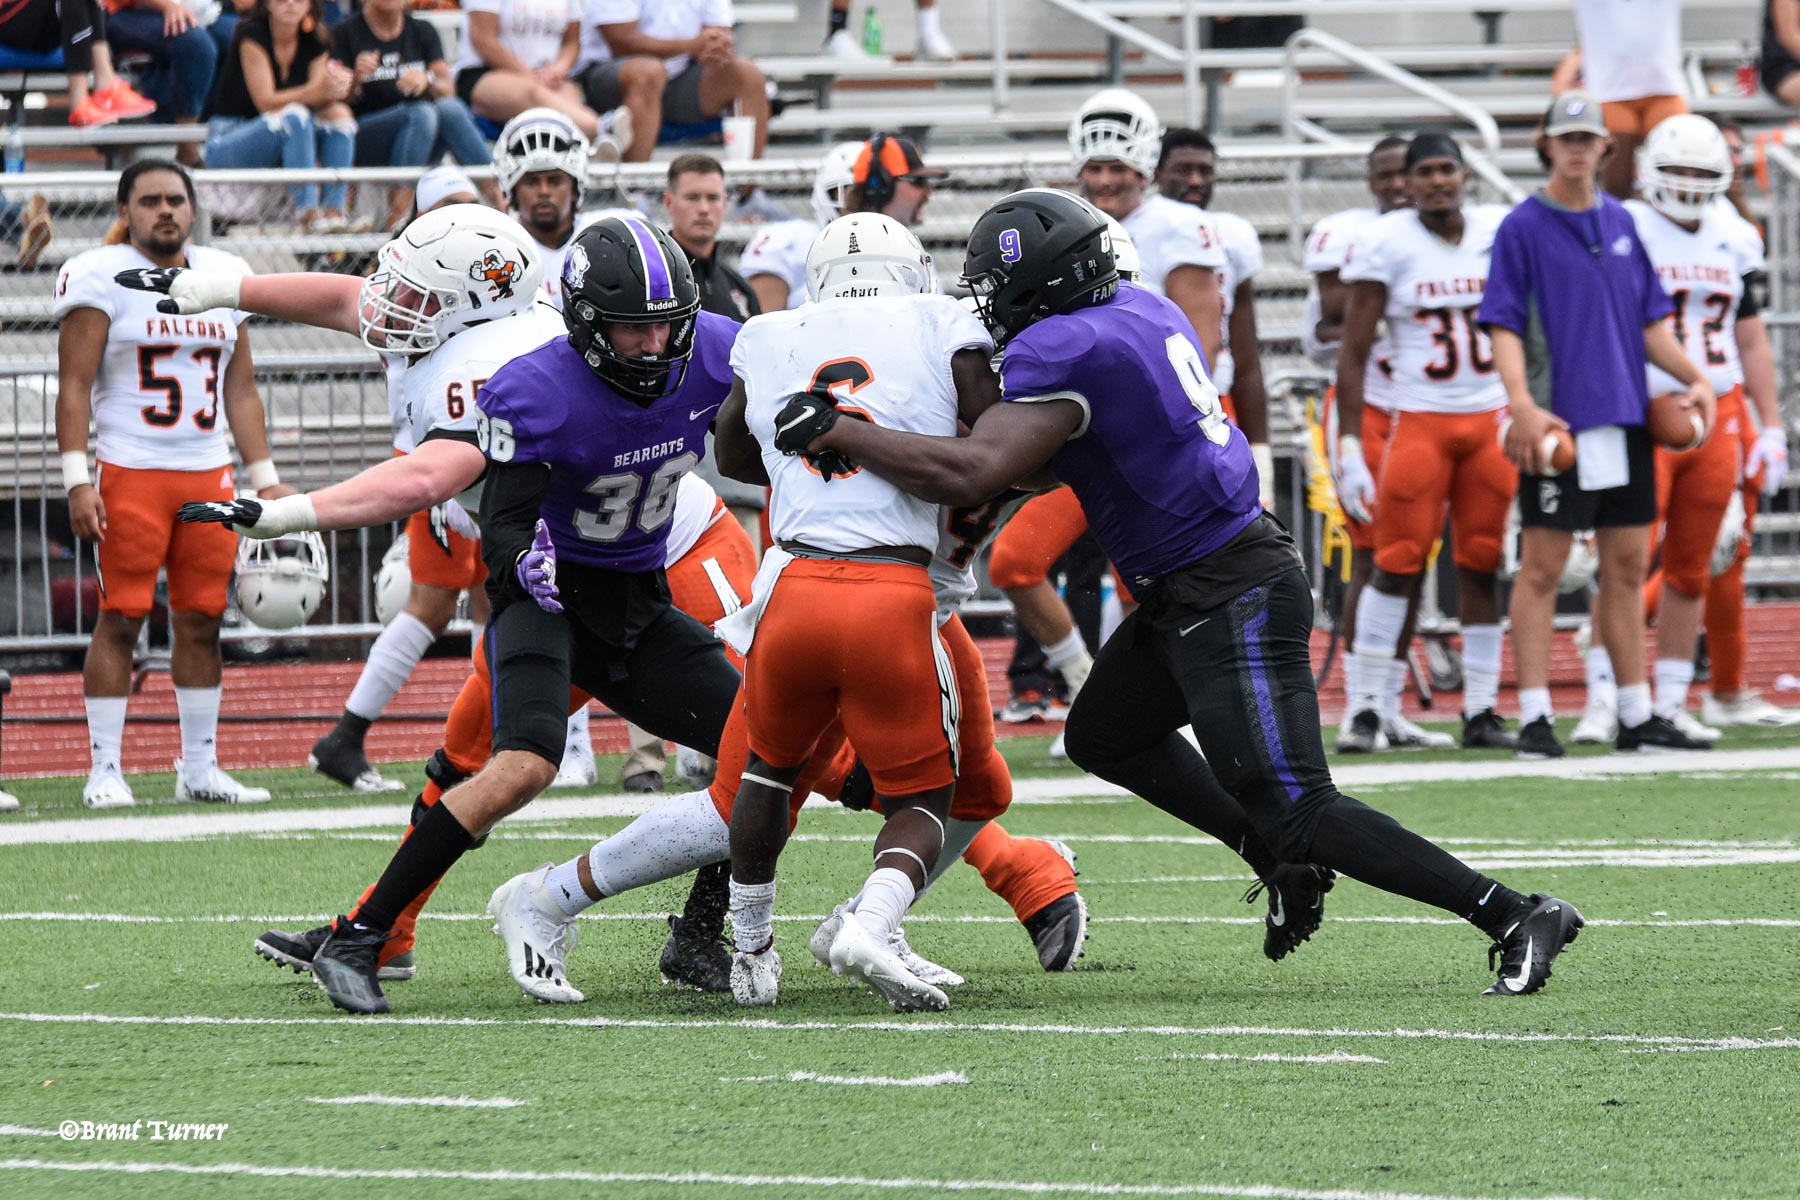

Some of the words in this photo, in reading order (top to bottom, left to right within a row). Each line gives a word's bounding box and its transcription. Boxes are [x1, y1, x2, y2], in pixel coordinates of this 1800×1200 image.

[999, 229, 1022, 263] 9
[851, 266, 858, 276] 6
[646, 300, 678, 312] Riddell
[146, 318, 227, 341] FALCONS
[136, 344, 223, 432] 53
[474, 404, 516, 463] 36
[613, 437, 684, 469] BEARCATS
[572, 450, 699, 543] 36
